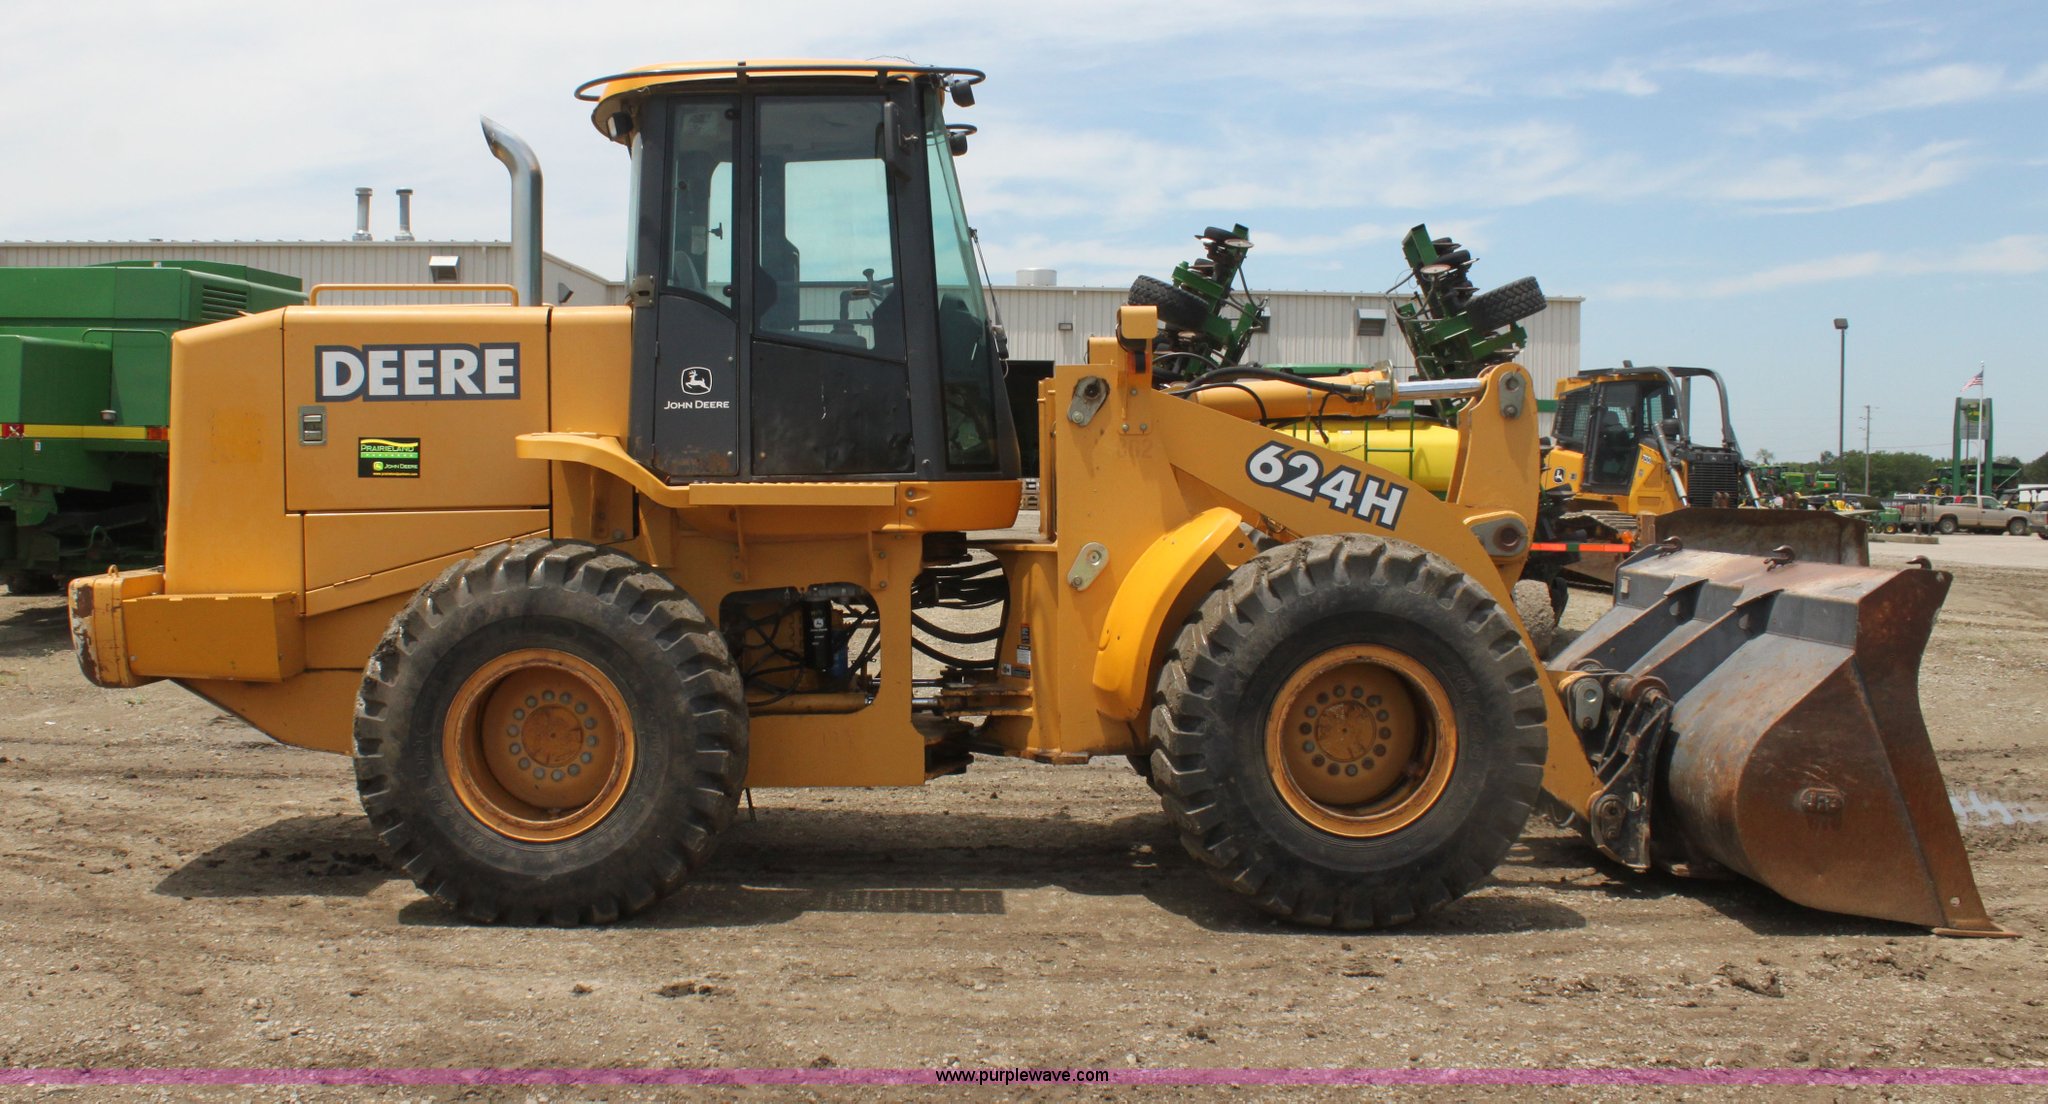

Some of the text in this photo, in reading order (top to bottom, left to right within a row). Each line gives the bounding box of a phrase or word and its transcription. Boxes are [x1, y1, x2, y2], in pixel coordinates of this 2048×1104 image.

[320, 347, 516, 397] DEERE
[663, 400, 730, 410] JOHN DEERE
[360, 444, 415, 452] PRAIRIELAND
[1247, 442, 1406, 528] 624H
